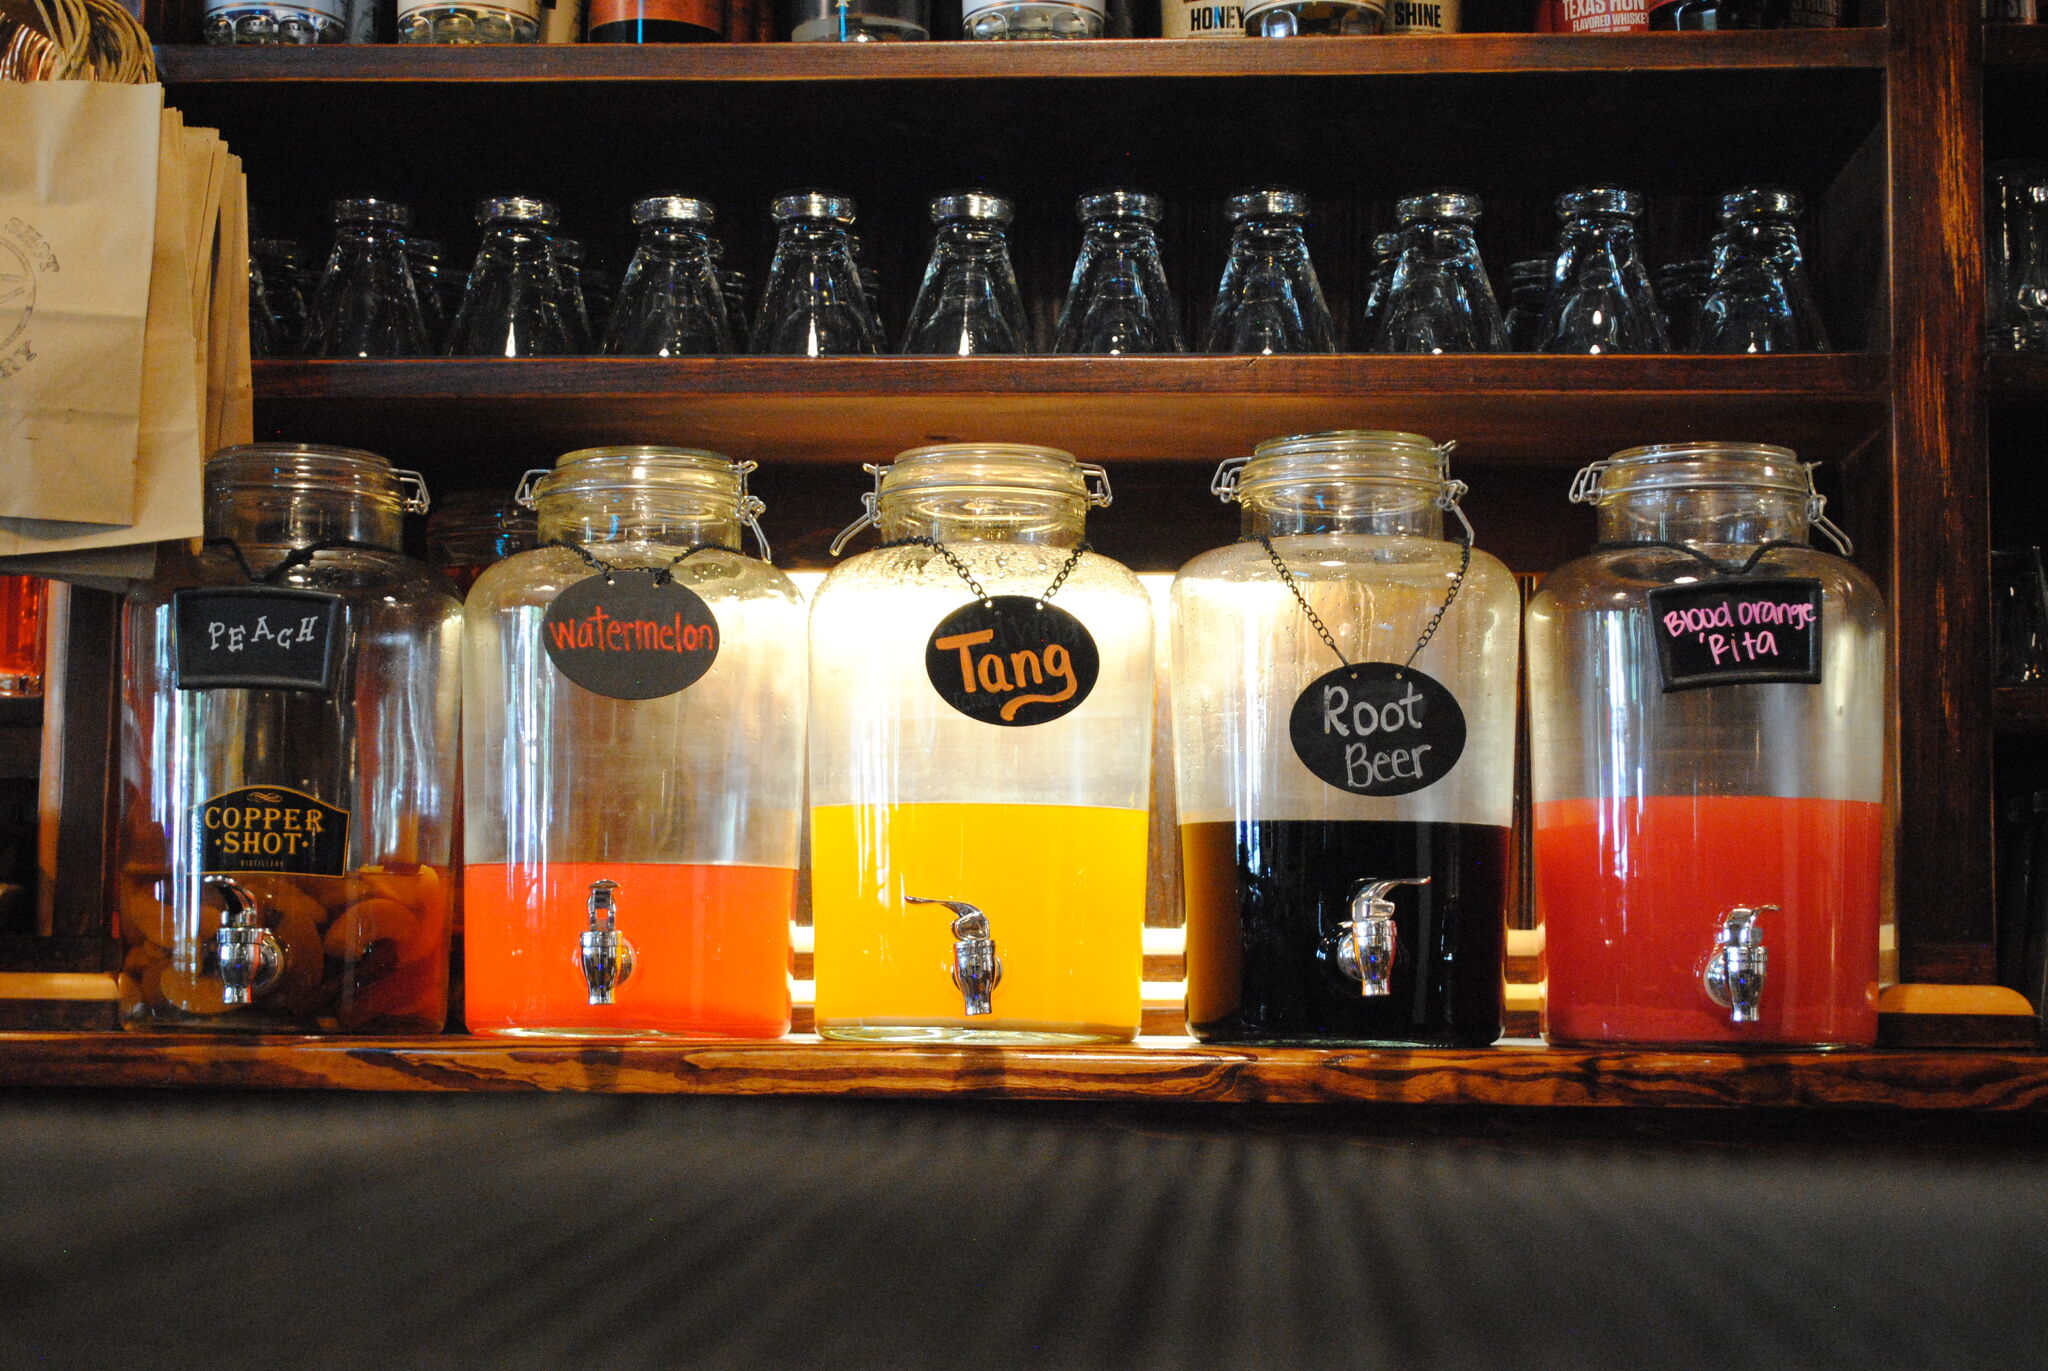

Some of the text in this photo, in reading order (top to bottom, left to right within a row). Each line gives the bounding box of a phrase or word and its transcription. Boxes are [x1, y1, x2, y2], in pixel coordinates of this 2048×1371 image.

[1190, 6, 1245, 31] HONEY
[1394, 2, 1441, 28] SHINE
[1562, 0, 1606, 21] TEXAS
[1573, 14, 1611, 33] FLAVORED
[208, 615, 319, 653] PEACH
[549, 605, 714, 654] watermelon
[1663, 601, 1735, 638] Blood
[935, 628, 1078, 721] Tang
[1323, 681, 1424, 736] Root
[1344, 742, 1432, 788] Beer
[204, 806, 325, 833] COPPER
[223, 831, 303, 856] SHOT
